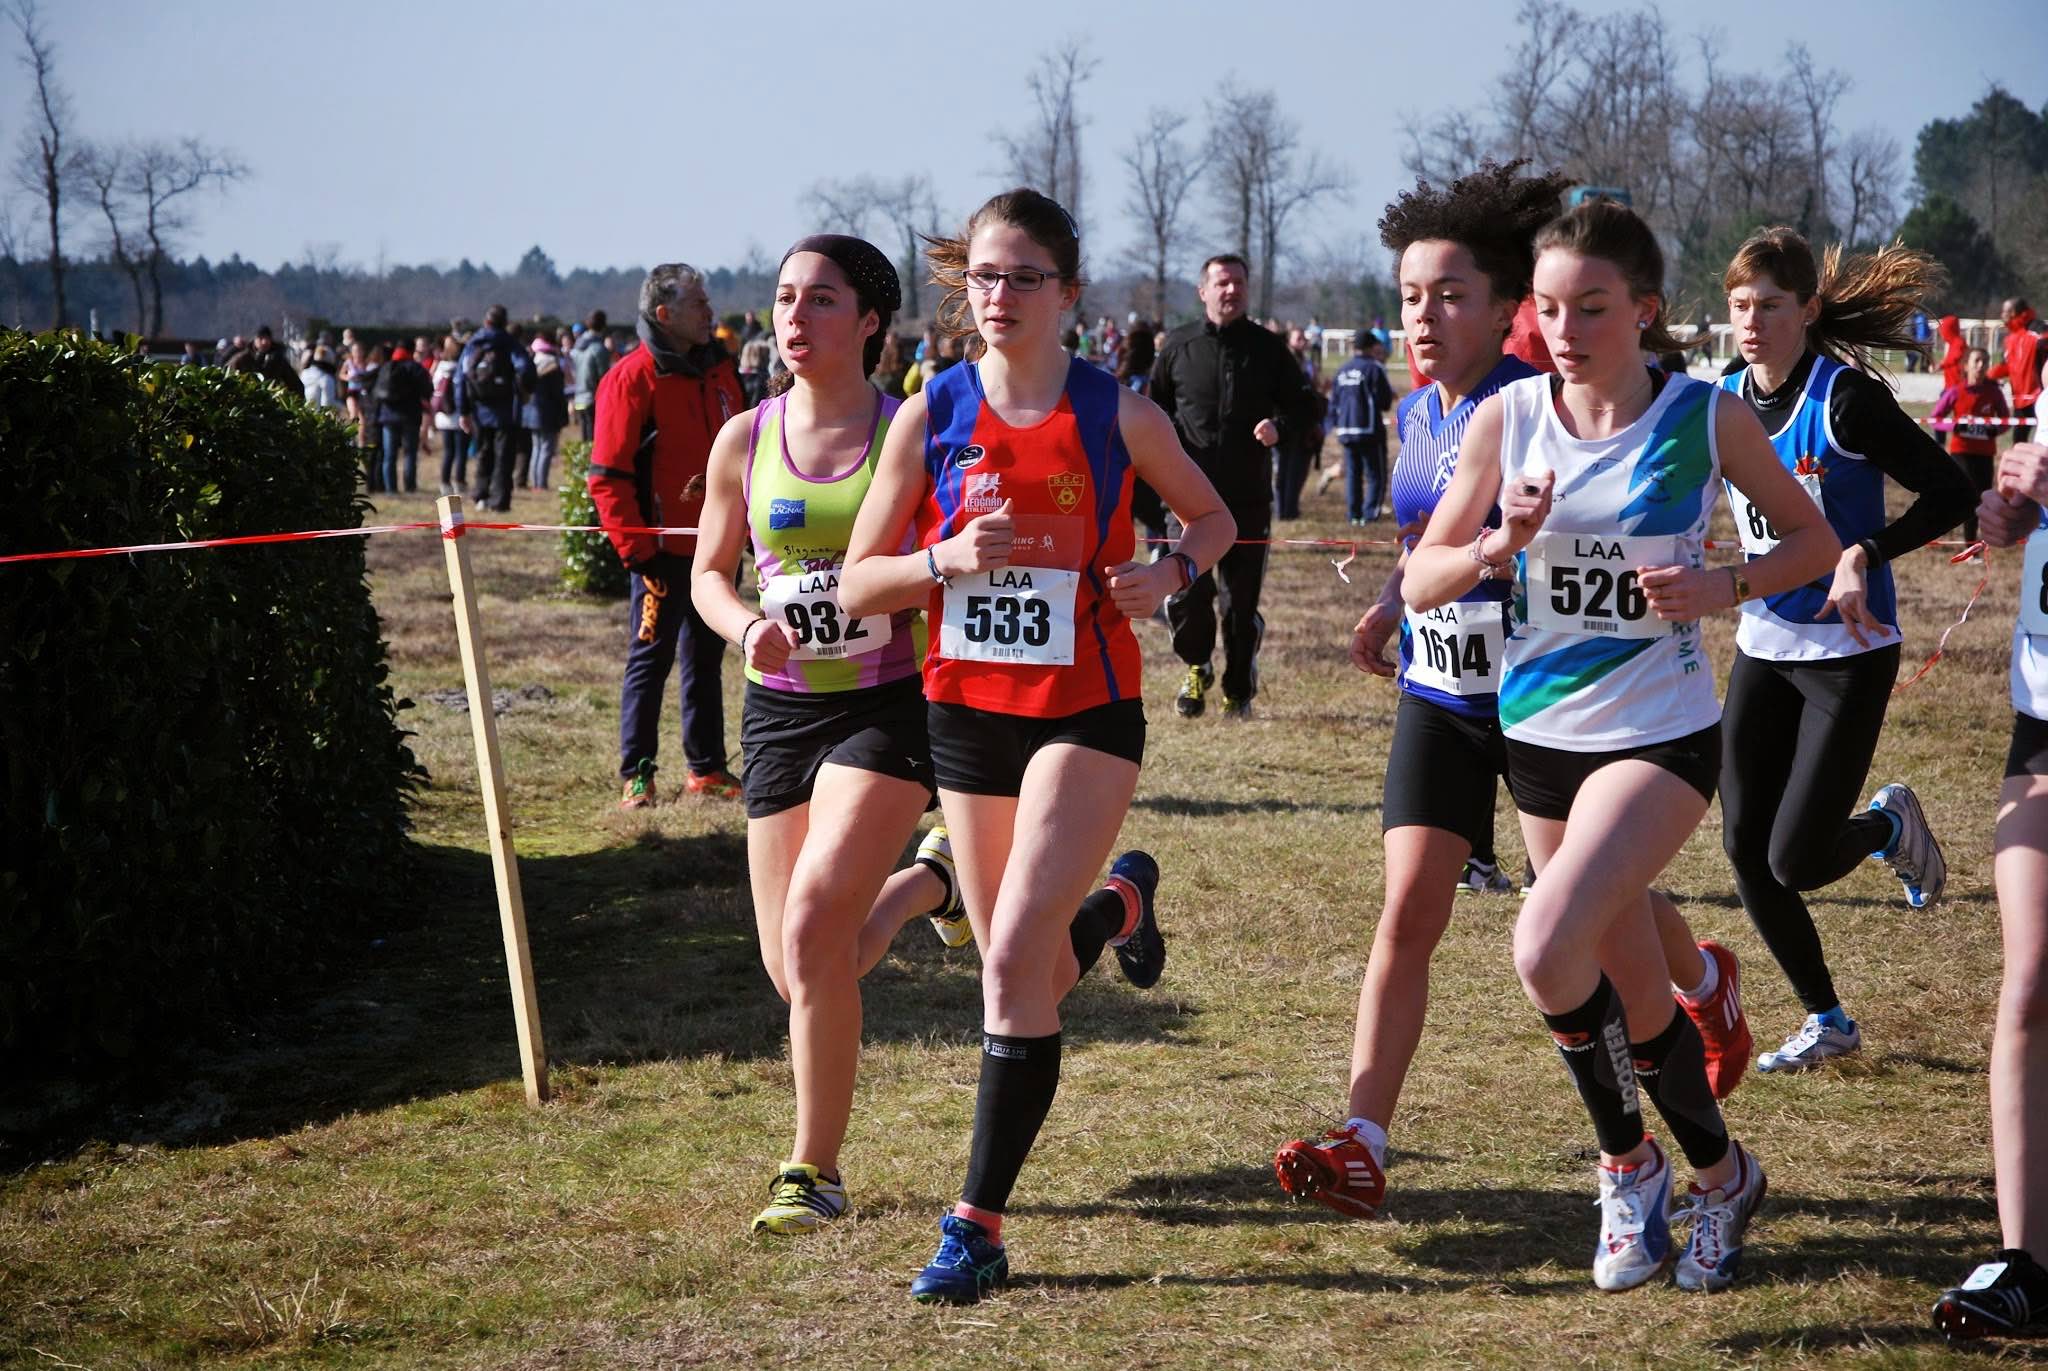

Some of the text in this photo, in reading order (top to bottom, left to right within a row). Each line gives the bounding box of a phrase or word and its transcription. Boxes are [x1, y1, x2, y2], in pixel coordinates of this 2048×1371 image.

[1575, 539, 1625, 560] LAA
[799, 574, 839, 594] LAA
[989, 570, 1033, 589] LAA
[1551, 566, 1648, 621] 526
[964, 596, 1050, 647] 533
[1426, 607, 1458, 625] LAA
[1419, 625, 1491, 679] 1614
[1602, 1017, 1639, 1115] BOOSTER
